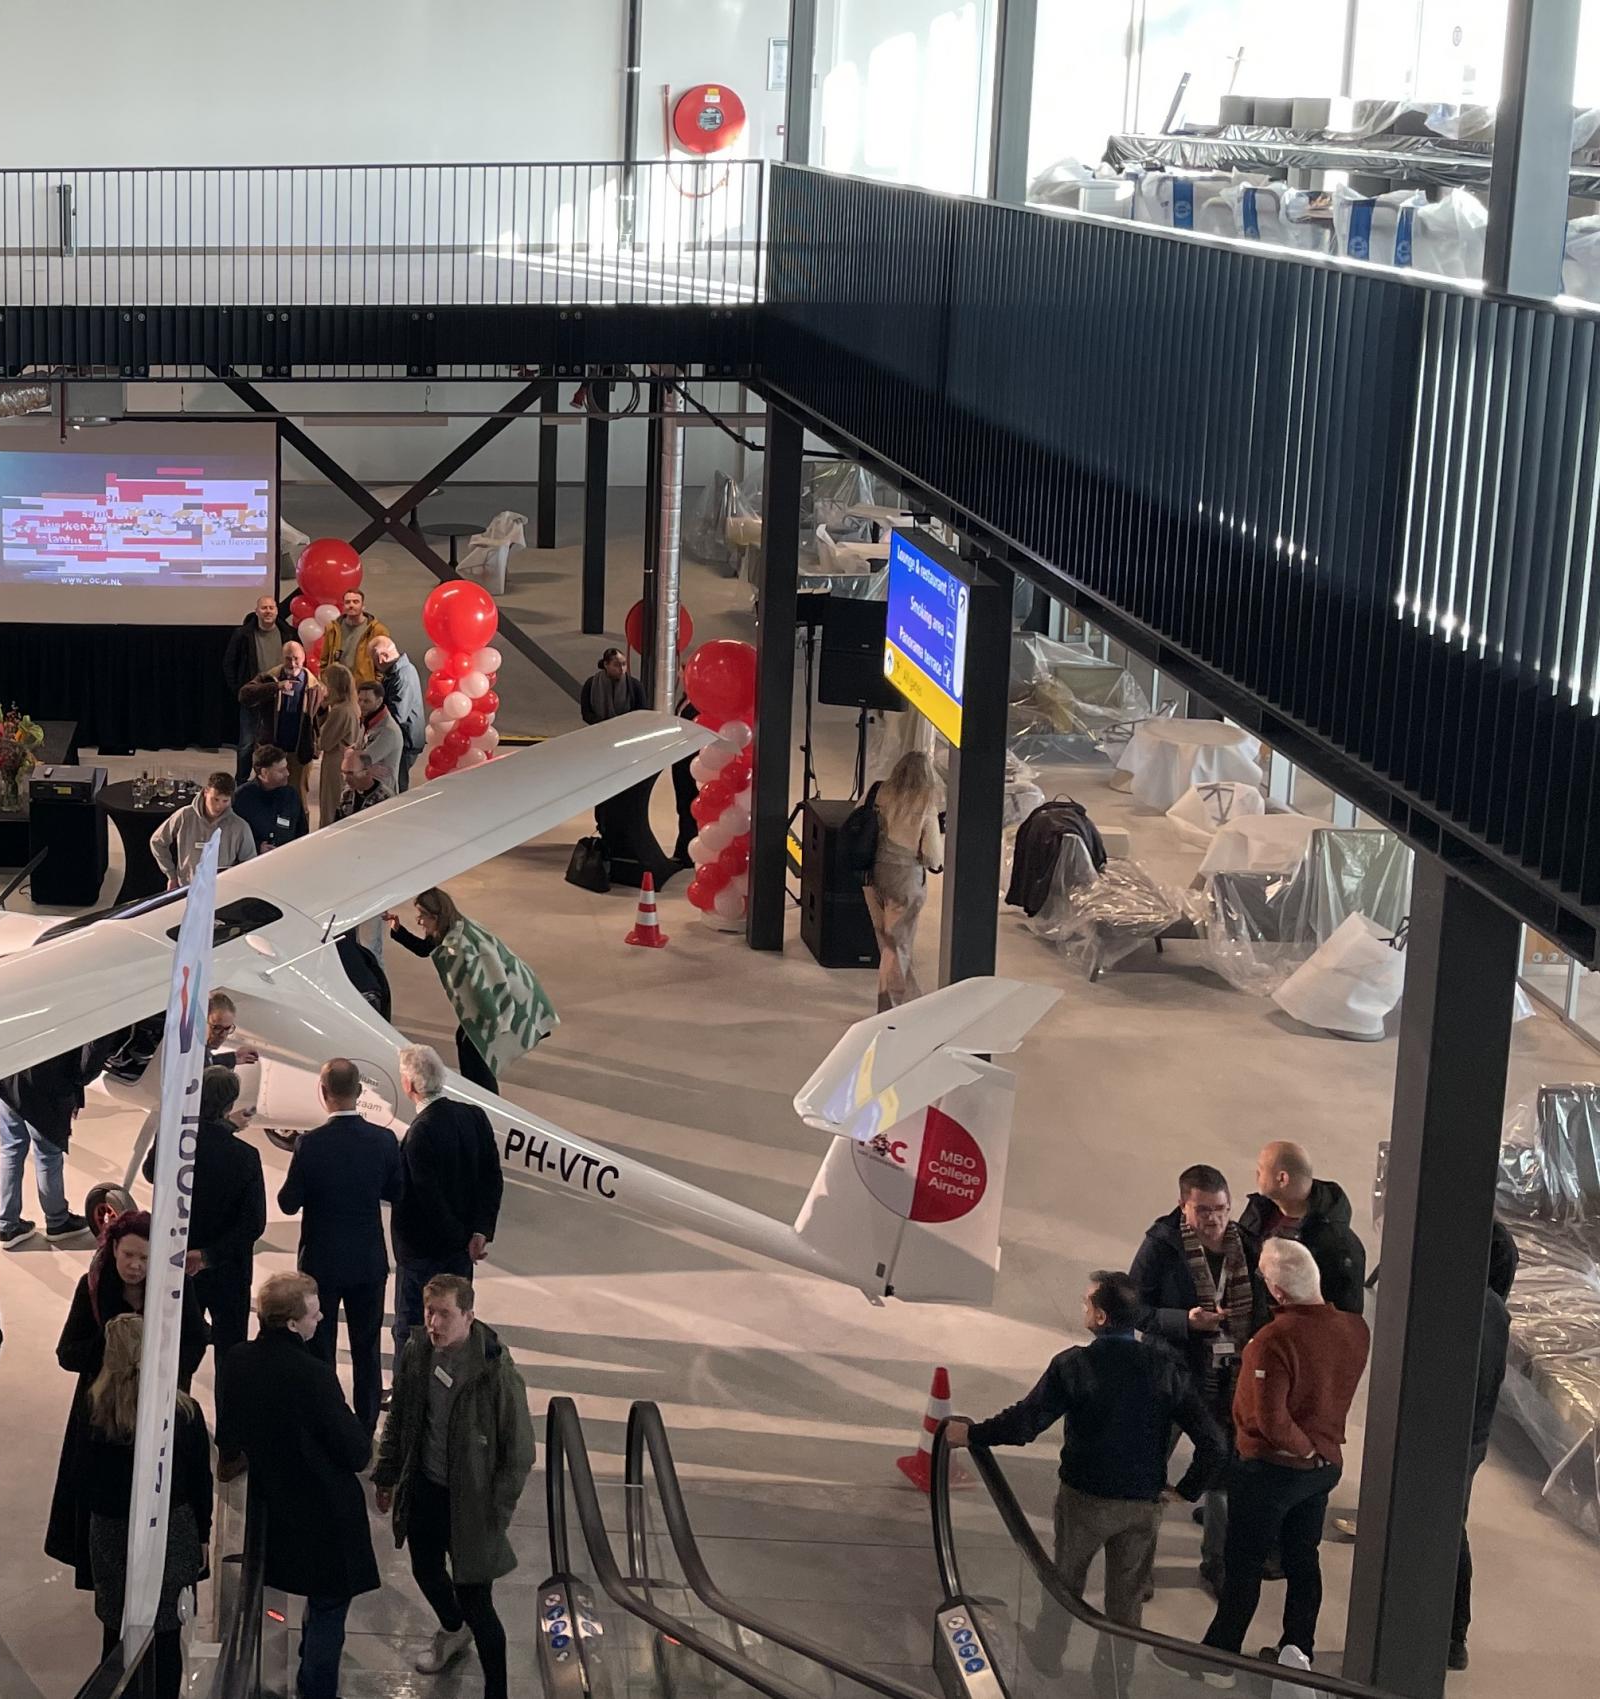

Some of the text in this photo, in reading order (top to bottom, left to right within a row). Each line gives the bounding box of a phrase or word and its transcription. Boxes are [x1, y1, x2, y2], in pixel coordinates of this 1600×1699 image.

[897, 544, 947, 597] Lounge & restaurant
[909, 596, 945, 637] Smoking area
[899, 625, 942, 677] Panorama terrace
[355, 1099, 383, 1113] zaam
[504, 1128, 619, 1199] PH-VTC
[928, 1160, 981, 1186] College
[940, 1150, 977, 1169] MBO
[928, 1176, 976, 1200] Airport
